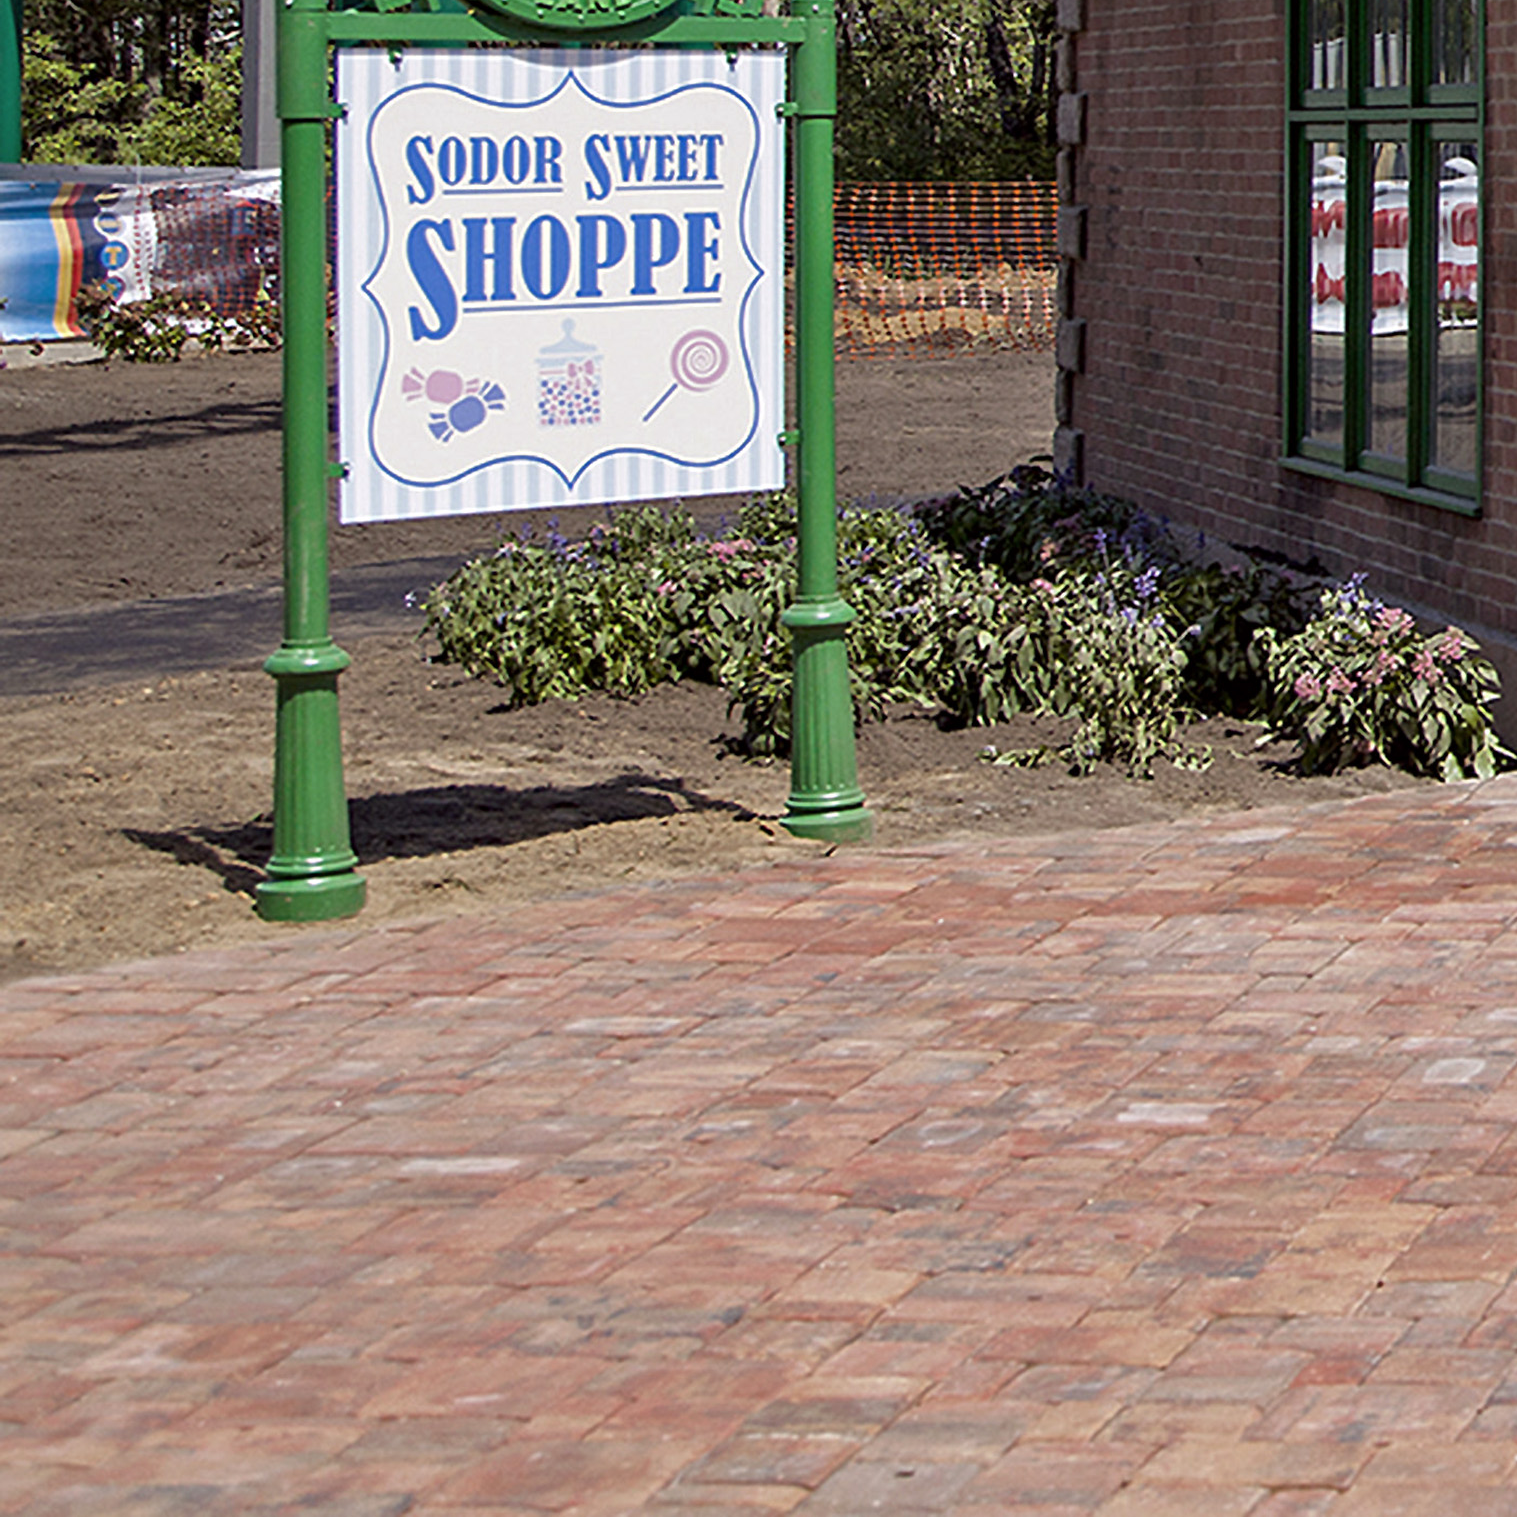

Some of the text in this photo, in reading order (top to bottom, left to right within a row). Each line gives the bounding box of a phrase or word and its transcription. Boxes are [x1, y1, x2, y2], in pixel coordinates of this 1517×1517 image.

[407, 134, 723, 204] SODOR SWEET
[406, 212, 721, 341] SHOPPE
